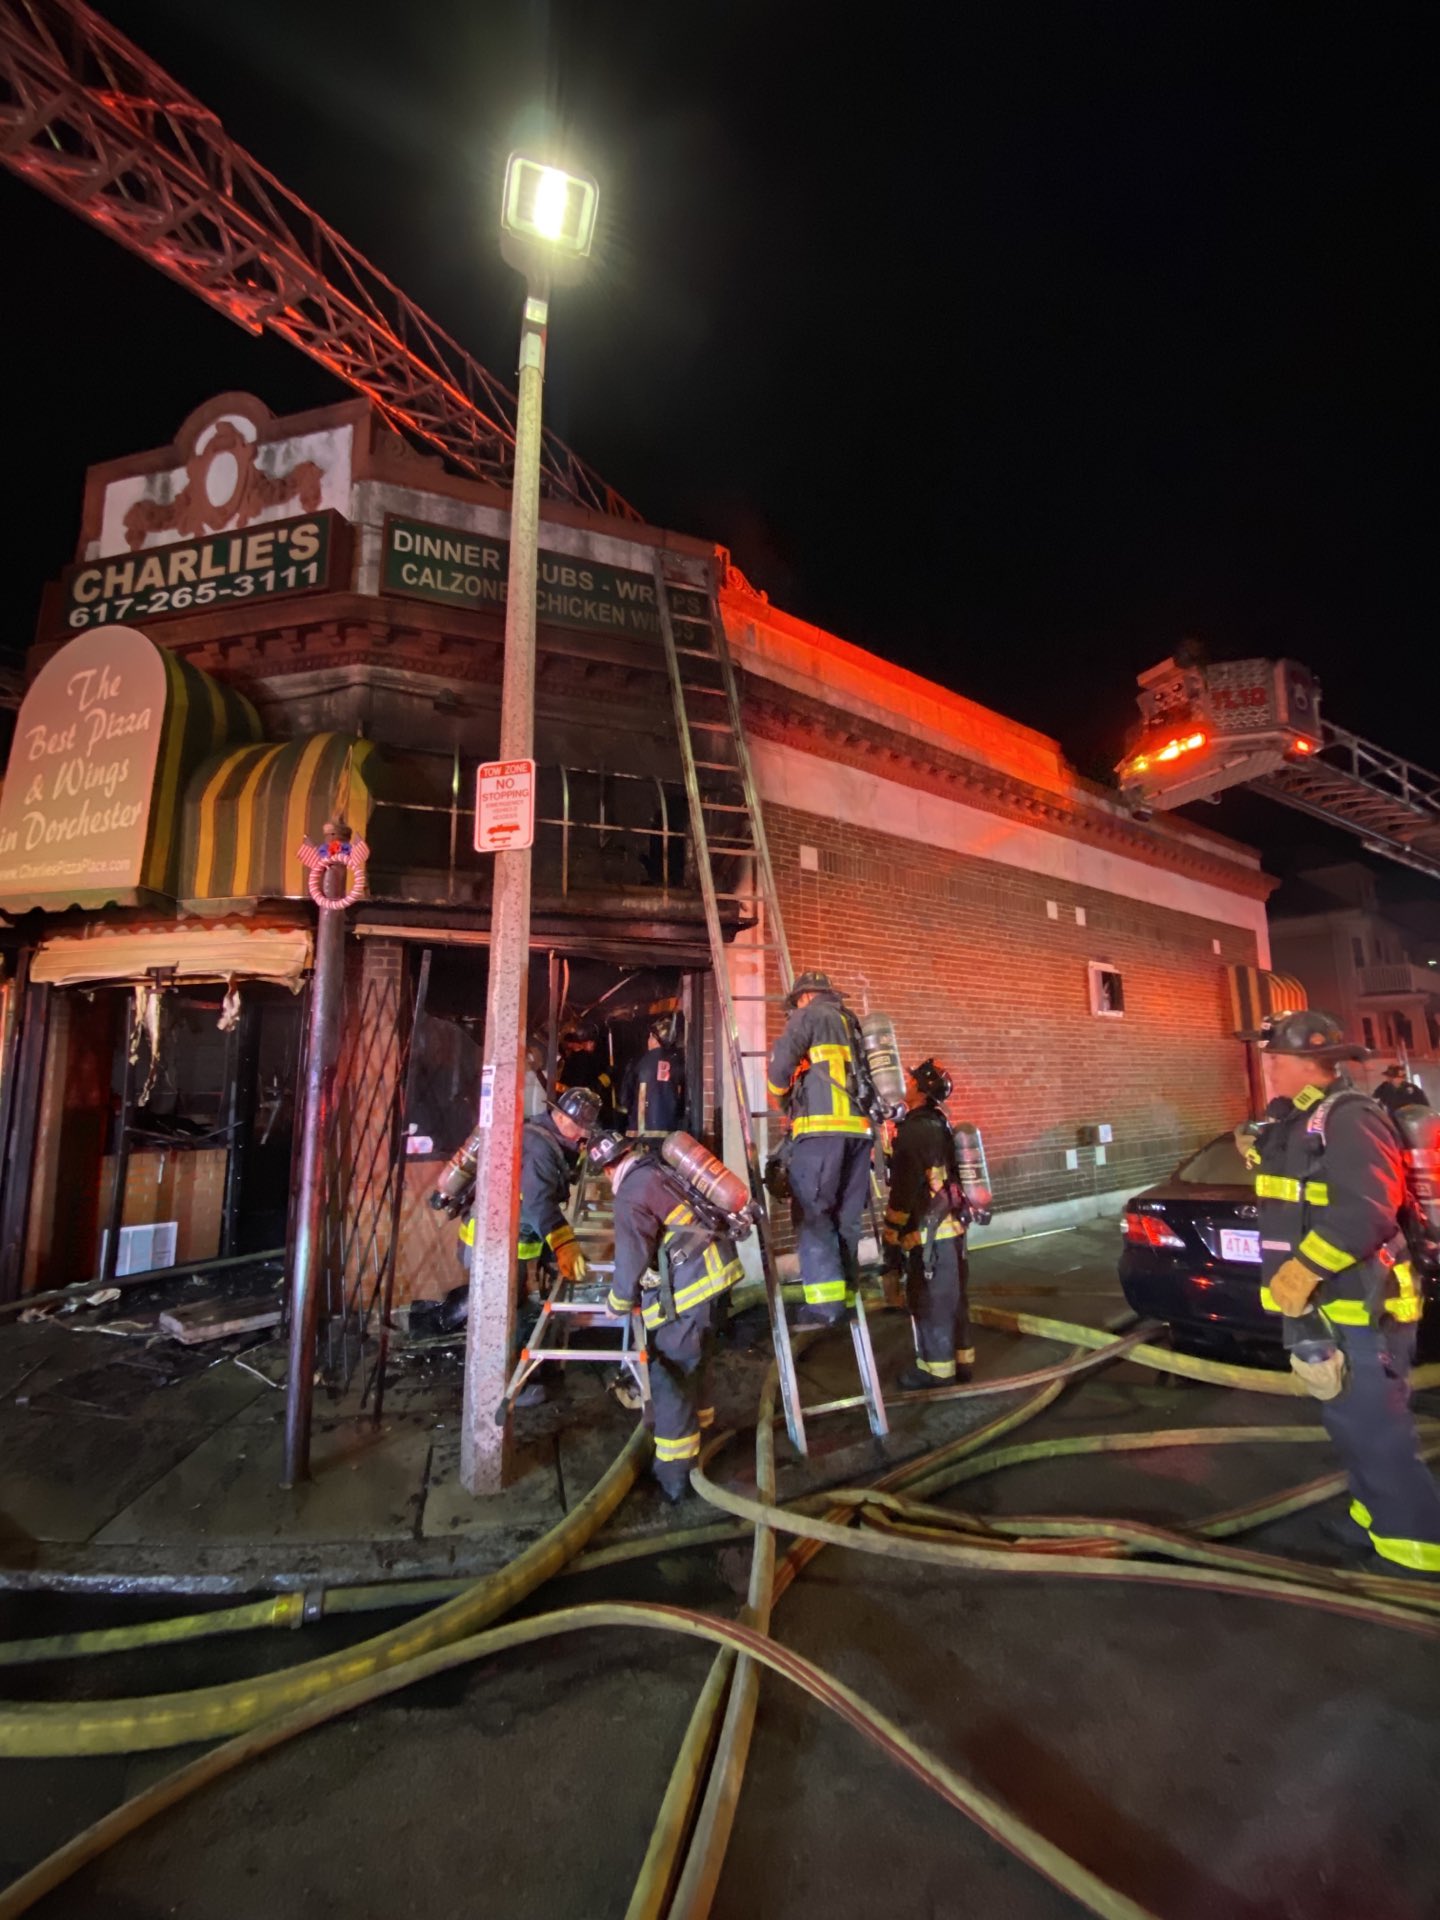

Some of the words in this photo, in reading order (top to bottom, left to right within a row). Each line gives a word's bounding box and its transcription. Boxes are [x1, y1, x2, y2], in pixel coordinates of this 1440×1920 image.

[73, 523, 320, 603] CHARLIE'S
[393, 529, 499, 570] DINNER
[536, 561, 595, 591] UBS
[615, 577, 702, 616] WRPS
[69, 562, 318, 627] 617-265-3111
[67, 664, 122, 712] The
[25, 723, 77, 760] Best
[84, 707, 151, 758] Pizza
[23, 773, 44, 805] &
[52, 756, 130, 798] Wings
[482, 788, 529, 802] STOPPING
[484, 767, 502, 777] TOW
[505, 763, 529, 775] ZONE
[496, 778, 515, 790] NO
[0, 827, 17, 854] in
[22, 798, 142, 851] Dorchester
